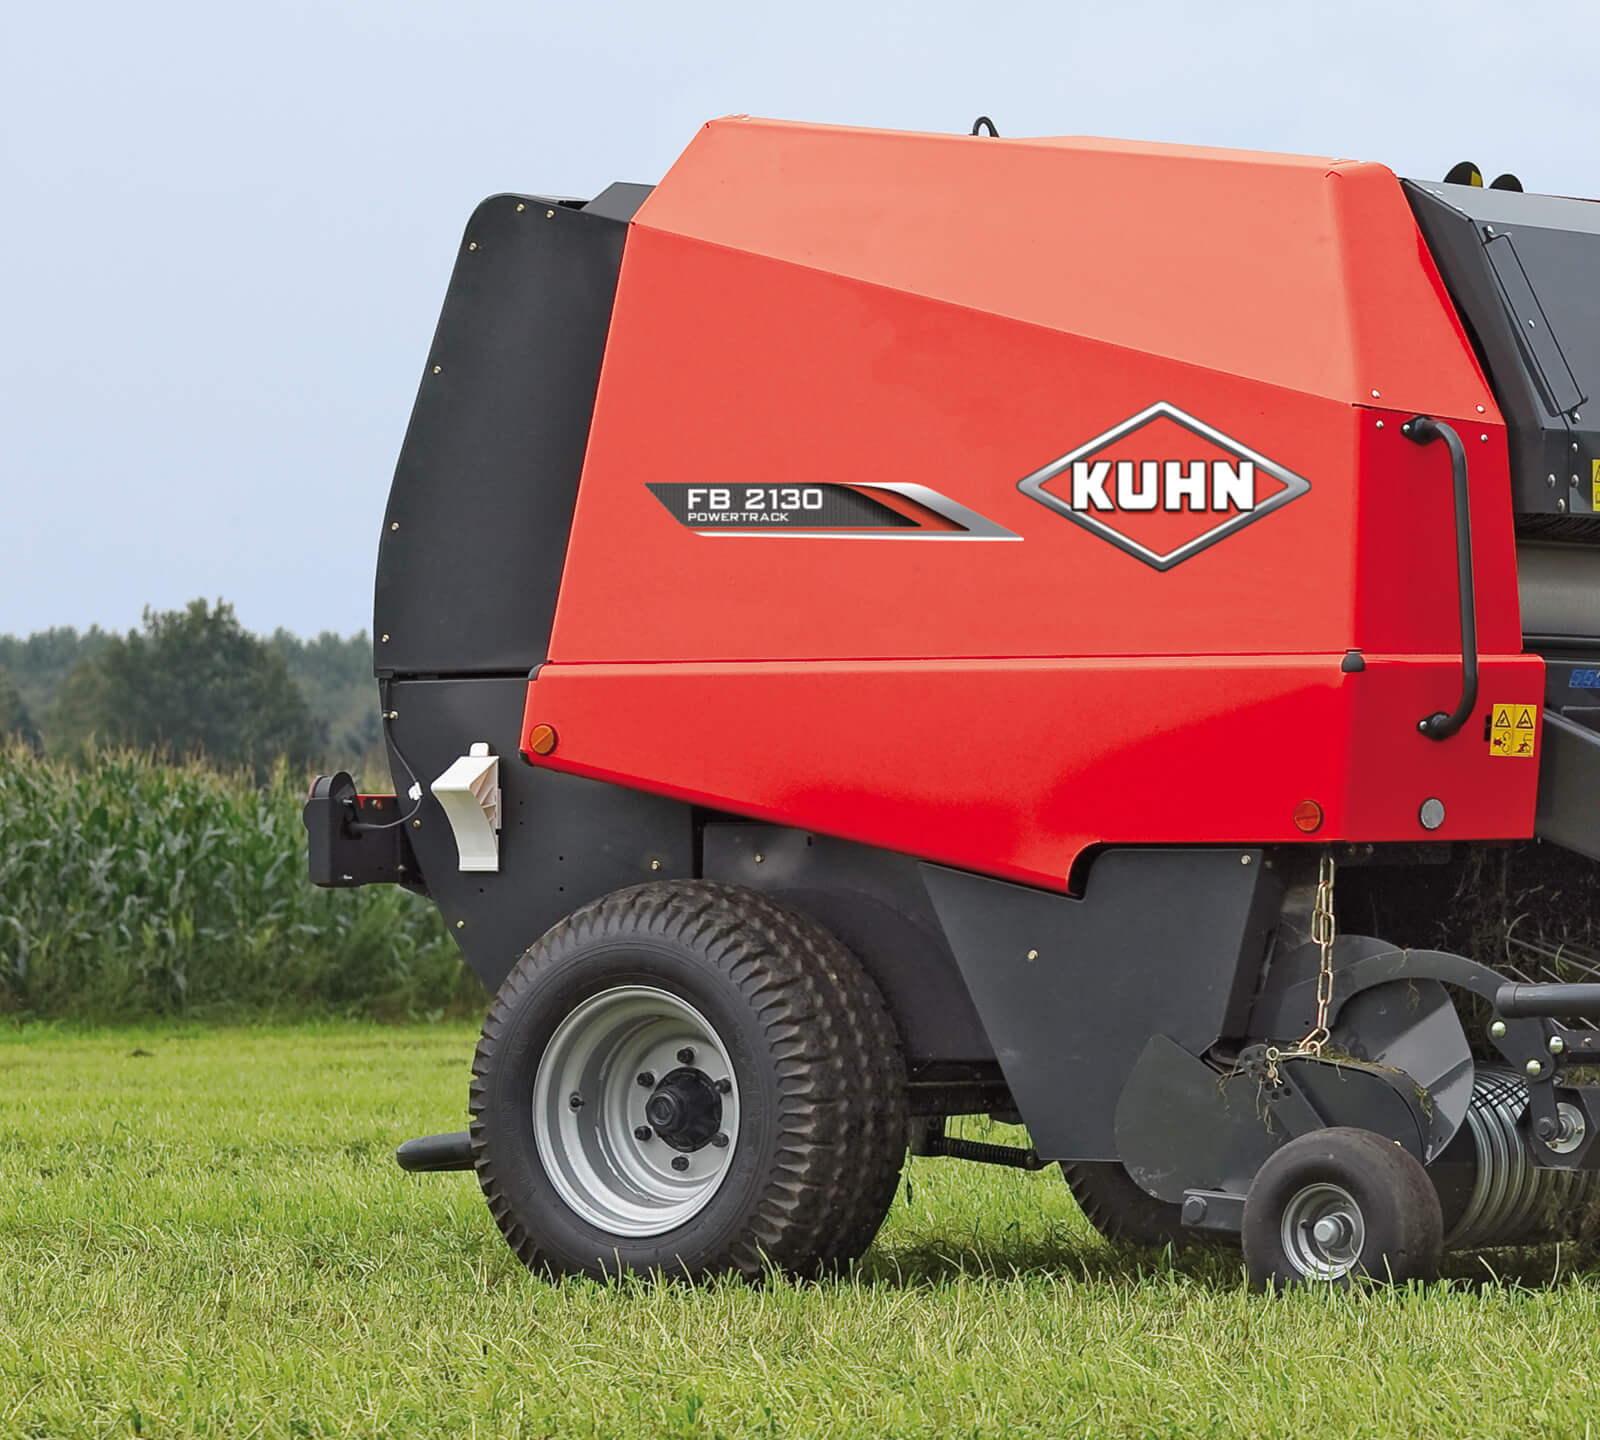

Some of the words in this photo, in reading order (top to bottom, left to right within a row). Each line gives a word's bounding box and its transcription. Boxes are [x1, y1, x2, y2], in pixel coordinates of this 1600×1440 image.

[1072, 461, 1254, 511] KUHN
[688, 489, 730, 509] FB
[745, 489, 822, 509] 2130
[688, 512, 789, 522] POWERTRACK
